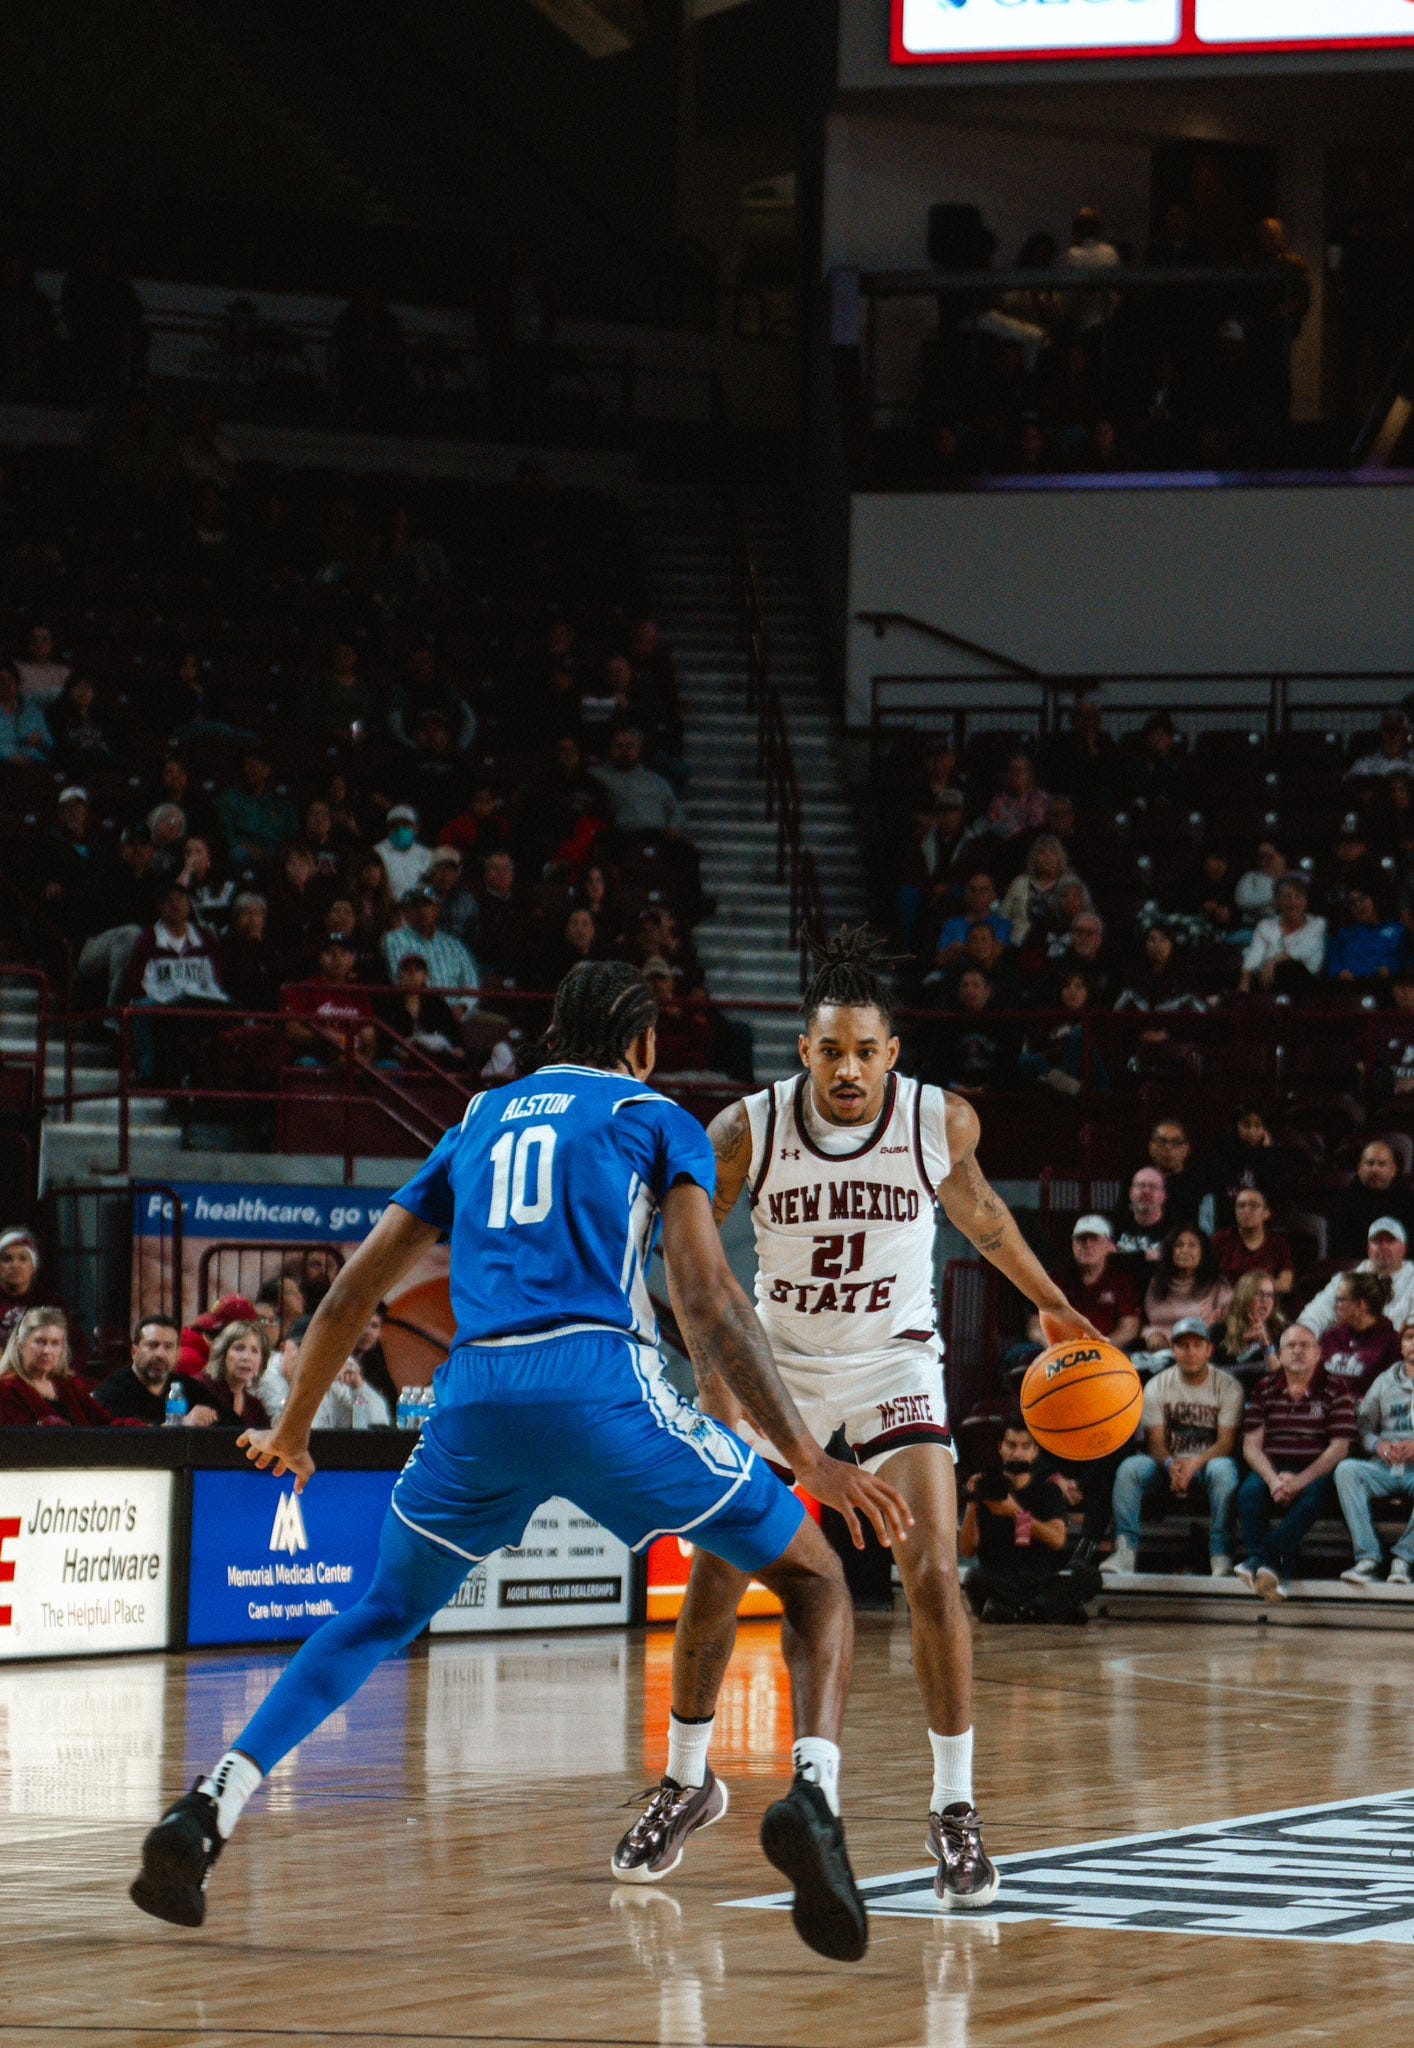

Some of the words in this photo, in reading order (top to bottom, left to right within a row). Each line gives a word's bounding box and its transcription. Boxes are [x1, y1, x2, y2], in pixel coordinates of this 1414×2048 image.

[500, 1092, 576, 1122] ALSTON
[487, 1124, 557, 1228] 10
[194, 1196, 321, 1227] healthcare,
[329, 1206, 361, 1231] go
[768, 1183, 822, 1225] NEW
[828, 1180, 919, 1223] MEXICO
[811, 1231, 867, 1280] 21
[769, 1273, 898, 1315] STATE
[1046, 1349, 1104, 1380] NCAA
[893, 1395, 933, 1423] STATE
[28, 1498, 137, 1535] Johnston's
[62, 1547, 160, 1584] Hardware
[228, 1564, 274, 1587] Memorial
[275, 1563, 316, 1585] Medical
[316, 1561, 352, 1584] Center
[506, 1586, 528, 1600] AGGIE
[528, 1585, 552, 1600] WHEEL
[552, 1584, 570, 1599] CLUB
[570, 1583, 615, 1598] DEALERSHIPS
[41, 1601, 64, 1628] The
[67, 1599, 111, 1632] Helpful
[113, 1599, 145, 1624] Place
[248, 1602, 269, 1620] Care
[270, 1601, 283, 1618] for
[284, 1603, 304, 1621] your
